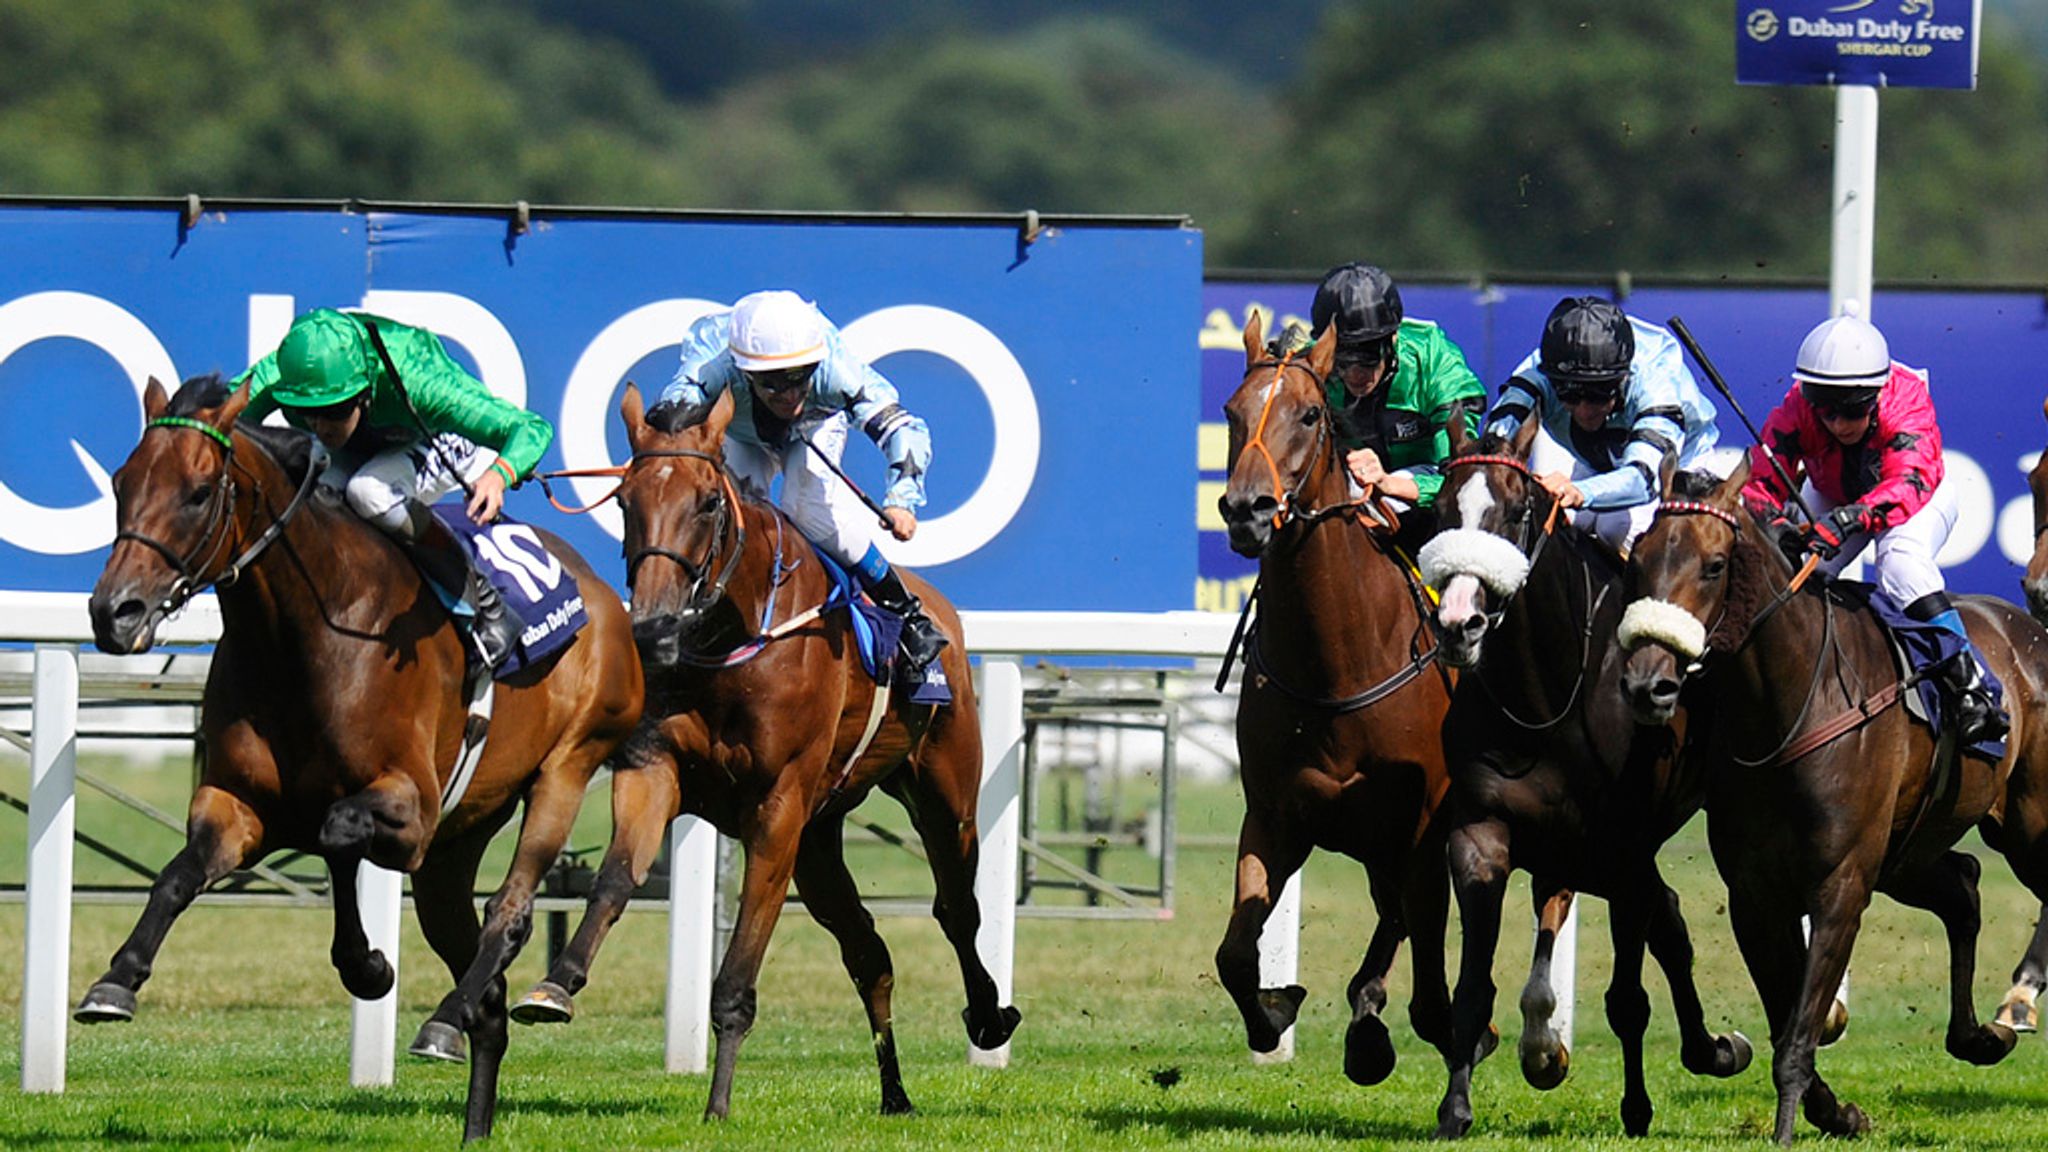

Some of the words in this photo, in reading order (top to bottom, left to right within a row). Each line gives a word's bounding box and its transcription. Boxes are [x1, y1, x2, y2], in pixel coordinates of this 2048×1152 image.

[1788, 17, 1854, 37] Dubai
[1857, 19, 1912, 43] Duty
[1915, 20, 1965, 41] Free
[1836, 41, 1901, 56] SHERGAR
[1903, 44, 1933, 57] CUP
[0, 287, 1042, 568] QCO
[473, 524, 562, 603] 10
[521, 621, 550, 647] ubai
